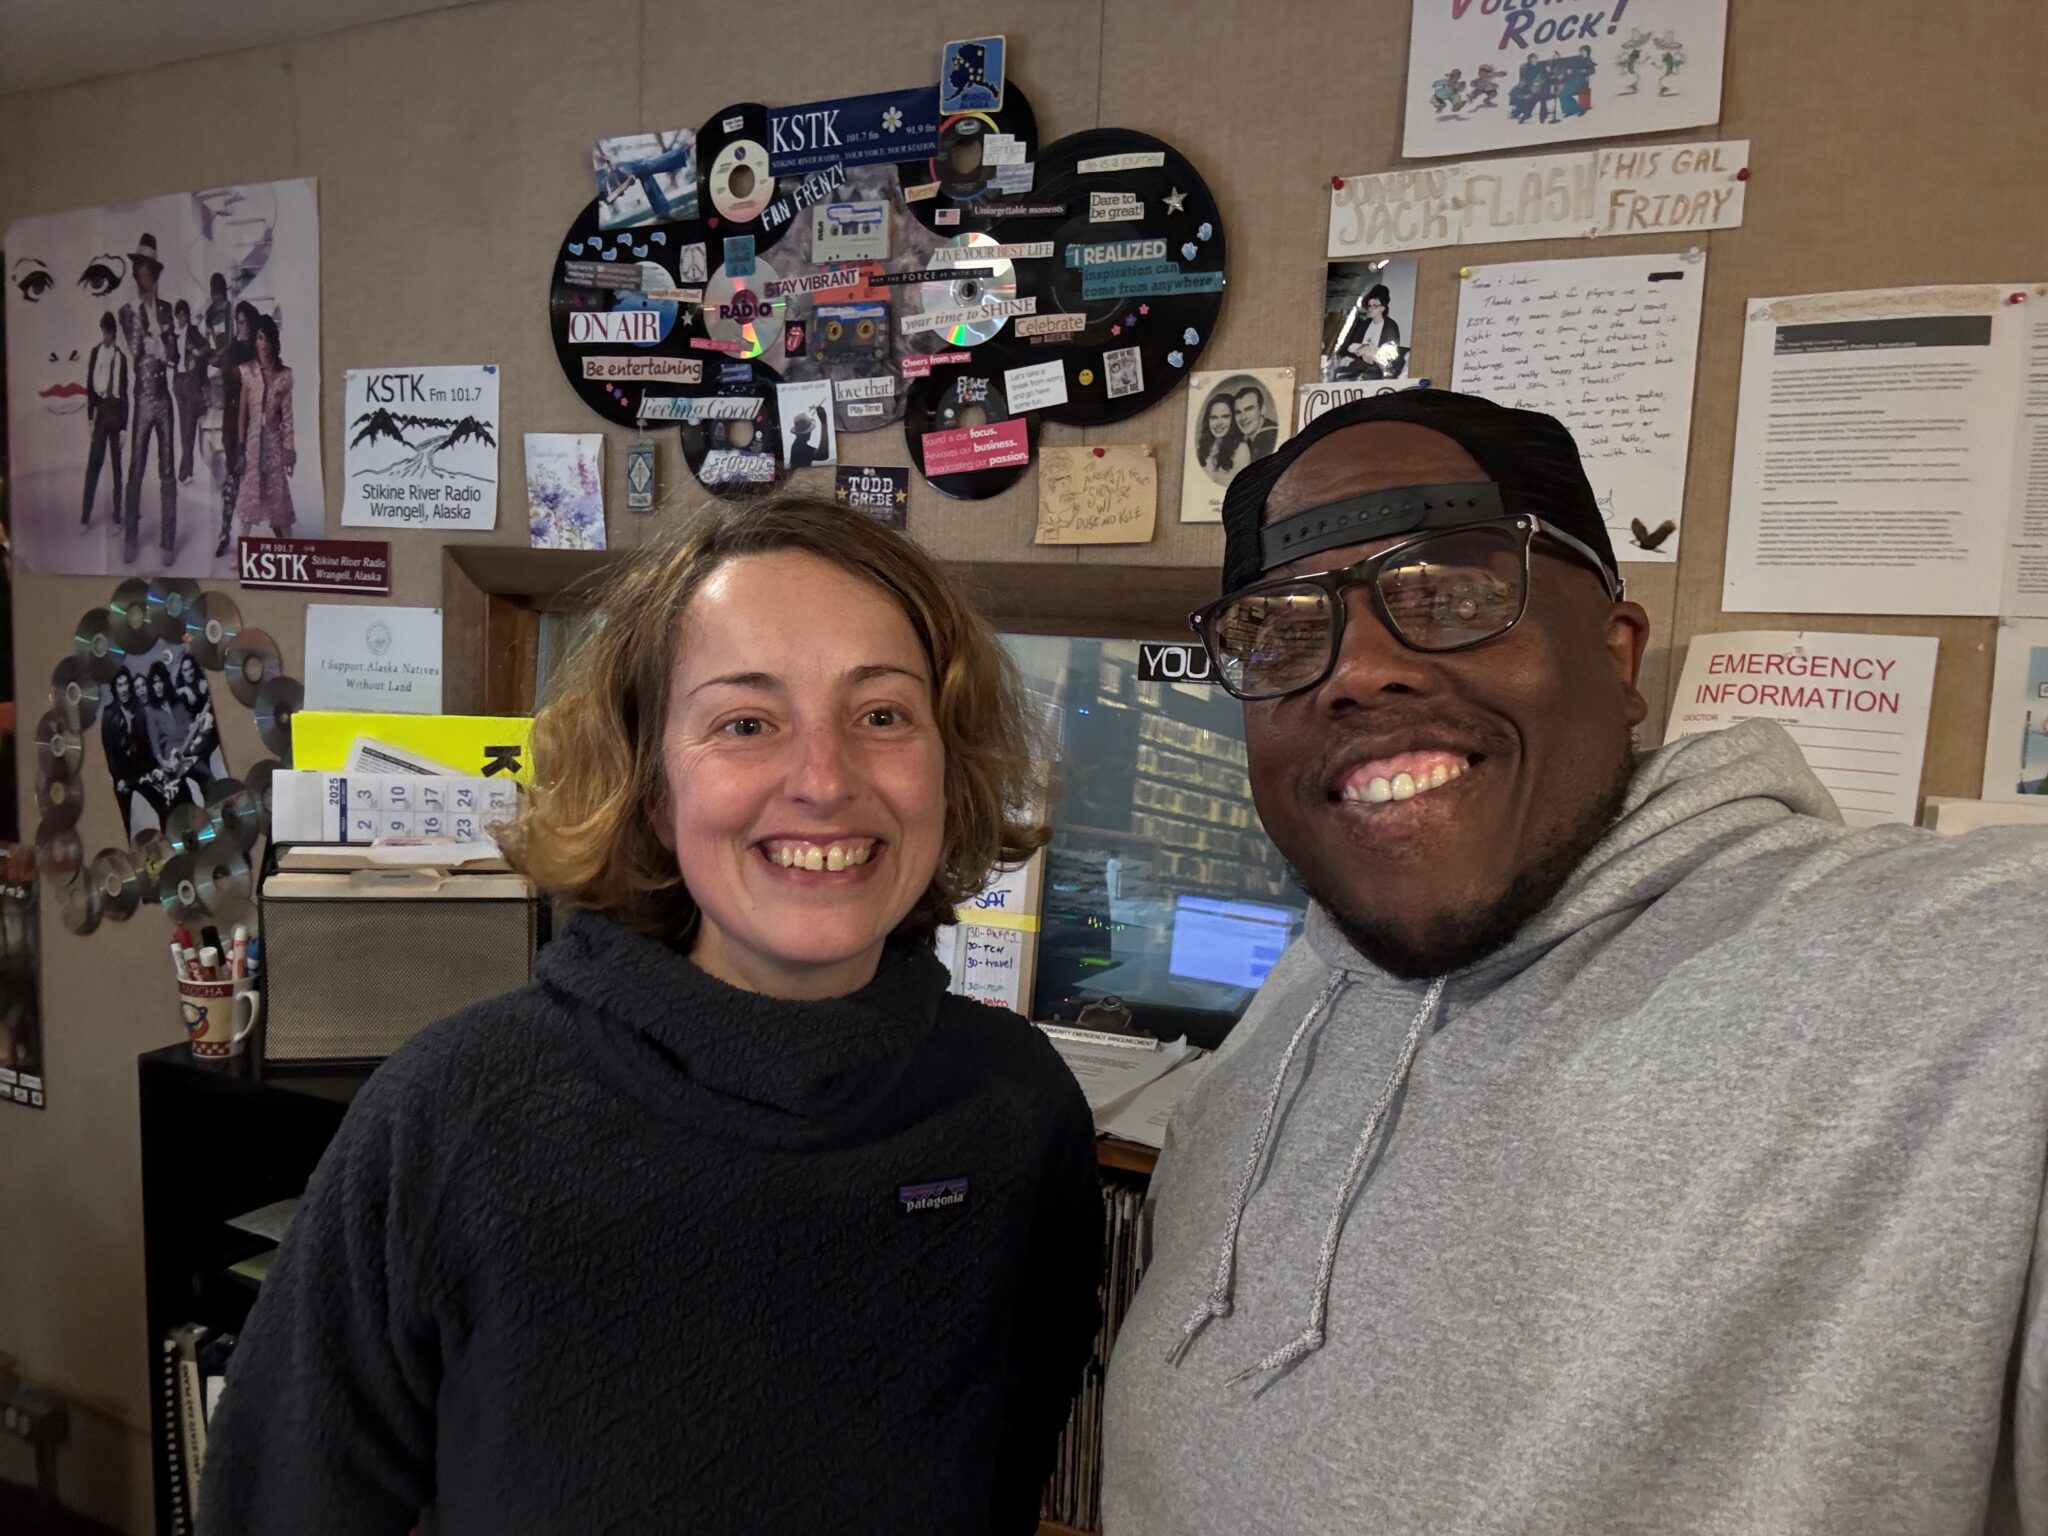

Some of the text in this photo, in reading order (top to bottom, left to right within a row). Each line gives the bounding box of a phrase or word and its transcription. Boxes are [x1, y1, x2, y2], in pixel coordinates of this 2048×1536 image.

[771, 109, 936, 154] KSTK 101.7 fm 91.9 fm
[908, 141, 936, 153] STATION
[1671, 149, 1727, 174] GAL
[761, 199, 791, 230] FAN
[793, 161, 847, 211] FRENZY
[1091, 194, 1135, 206] Dare to
[974, 206, 1064, 217] Unforgettable moments
[1091, 204, 1143, 220] be great!
[1609, 187, 1733, 231] FRIDAY
[935, 243, 1054, 262] LIVE YOUR BEST LIFE
[1084, 241, 1166, 265] REALIZED
[902, 272, 936, 282] FORCE
[1085, 263, 1178, 282] inspiration can
[765, 270, 857, 297] STAY VIBRANT
[1084, 284, 1116, 297] come
[1119, 281, 1149, 295] from
[719, 303, 772, 319] RADIO
[904, 299, 1034, 331] your time to SHINE
[570, 313, 658, 341] ON AIR
[1015, 316, 1084, 335] Celebrate
[1467, 316, 1495, 328] KSTK
[1606, 332, 1647, 342] stations
[586, 361, 604, 376] Be
[608, 359, 702, 381] entertaining
[903, 353, 971, 368] Cheers from your
[1463, 361, 1504, 372] Anchorage
[903, 368, 929, 378] friends
[366, 374, 482, 403] KSTK Fm 101.7
[836, 382, 863, 401] love
[865, 378, 894, 397] that!
[642, 397, 761, 421] Feeling Good
[849, 403, 881, 415] Play Time
[922, 434, 947, 446] Sound
[970, 427, 998, 439] focus.
[973, 439, 1018, 453] business.
[975, 458, 988, 468] our
[989, 451, 1029, 467] passion.
[362, 484, 482, 502] Stikine River Radio
[848, 476, 894, 493] TODD
[849, 493, 894, 507] GREBE
[371, 503, 471, 522] Wrangell, Alaska
[273, 544, 294, 553] 101.7
[312, 555, 386, 568] Stikine River Radio
[354, 571, 382, 582] Alaska
[321, 659, 440, 675] I Support Alaska Natives
[1144, 645, 1210, 679] YOU
[1708, 653, 1897, 681] EMERGENCY
[346, 678, 413, 692] Without Land
[1695, 684, 1900, 714] INFORMATION
[1683, 714, 1719, 722] DOCTOR
[481, 746, 522, 777] K
[329, 778, 340, 805] 2025
[357, 789, 372, 829] 2 3
[391, 786, 405, 830] 9 10
[425, 788, 439, 834] 16 17
[457, 789, 471, 837] 23 24
[976, 890, 1011, 909] SAT
[182, 985, 224, 997] MOCHA
[1072, 1031, 1107, 1041] EMERGENCY
[906, 1192, 966, 1213] patagonia
[182, 1364, 191, 1397] PLANS
[189, 1422, 198, 1451] STATE
